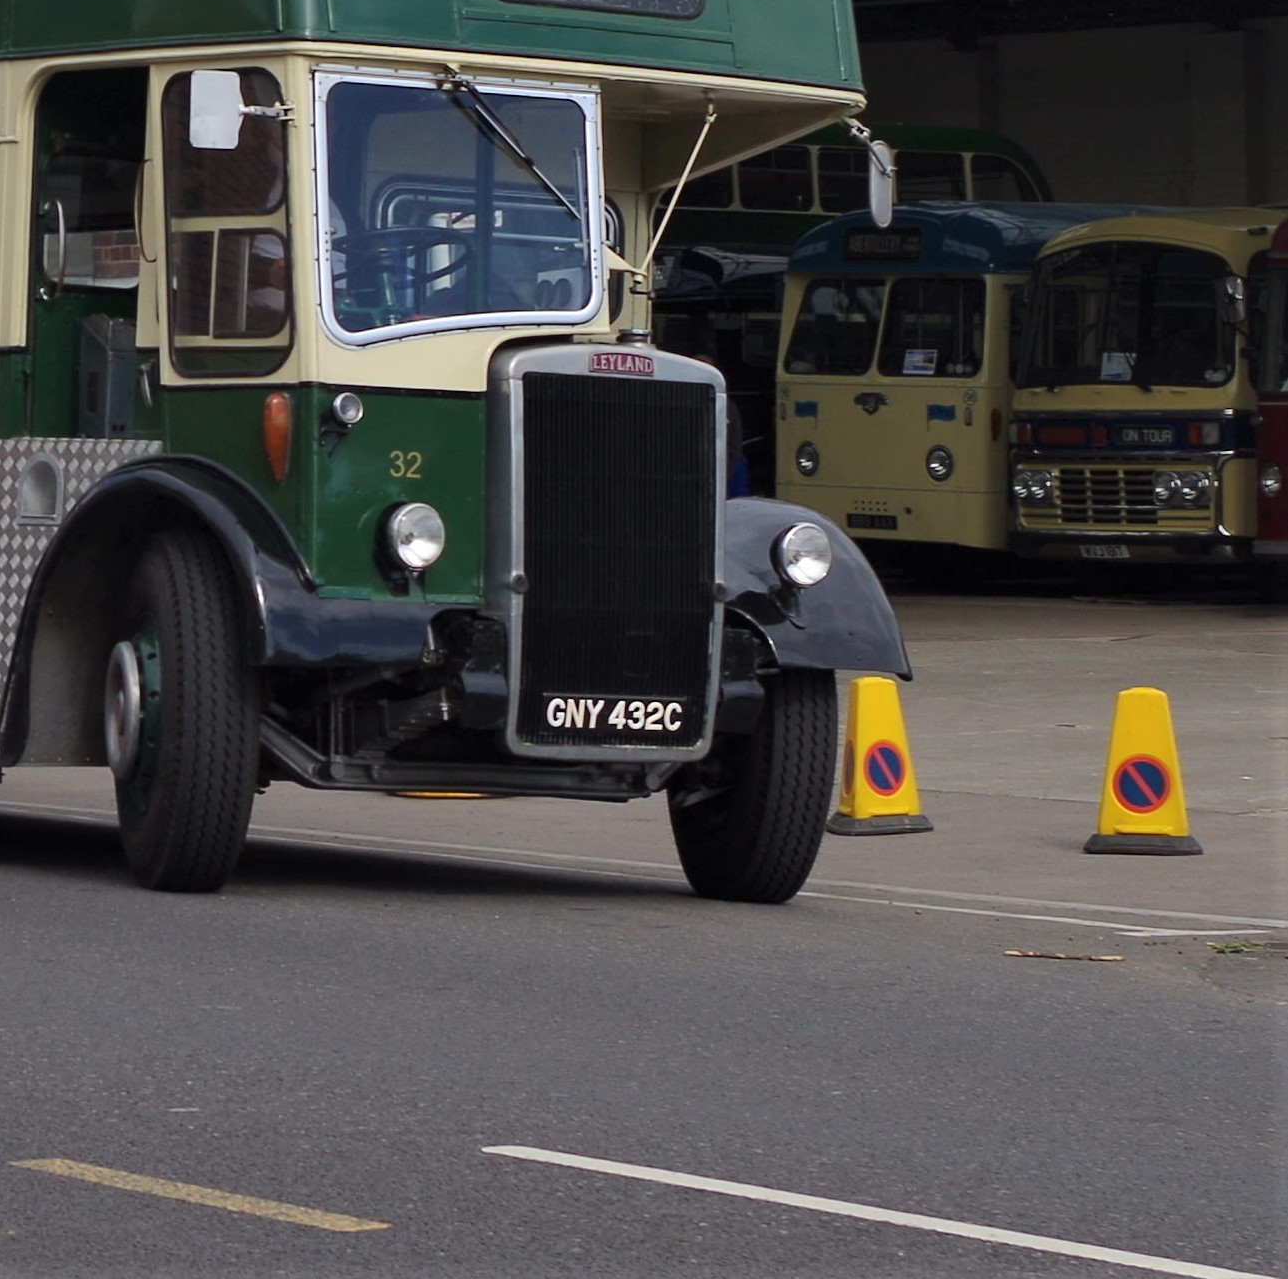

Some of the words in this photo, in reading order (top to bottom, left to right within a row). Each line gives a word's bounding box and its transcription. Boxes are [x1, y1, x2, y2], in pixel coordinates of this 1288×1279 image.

[593, 354, 653, 373] LEYLAND
[1123, 429, 1138, 441] ON
[1143, 429, 1172, 443] TOUR
[390, 450, 422, 478] 32
[546, 697, 605, 729] GNY
[608, 700, 682, 731] 432C
